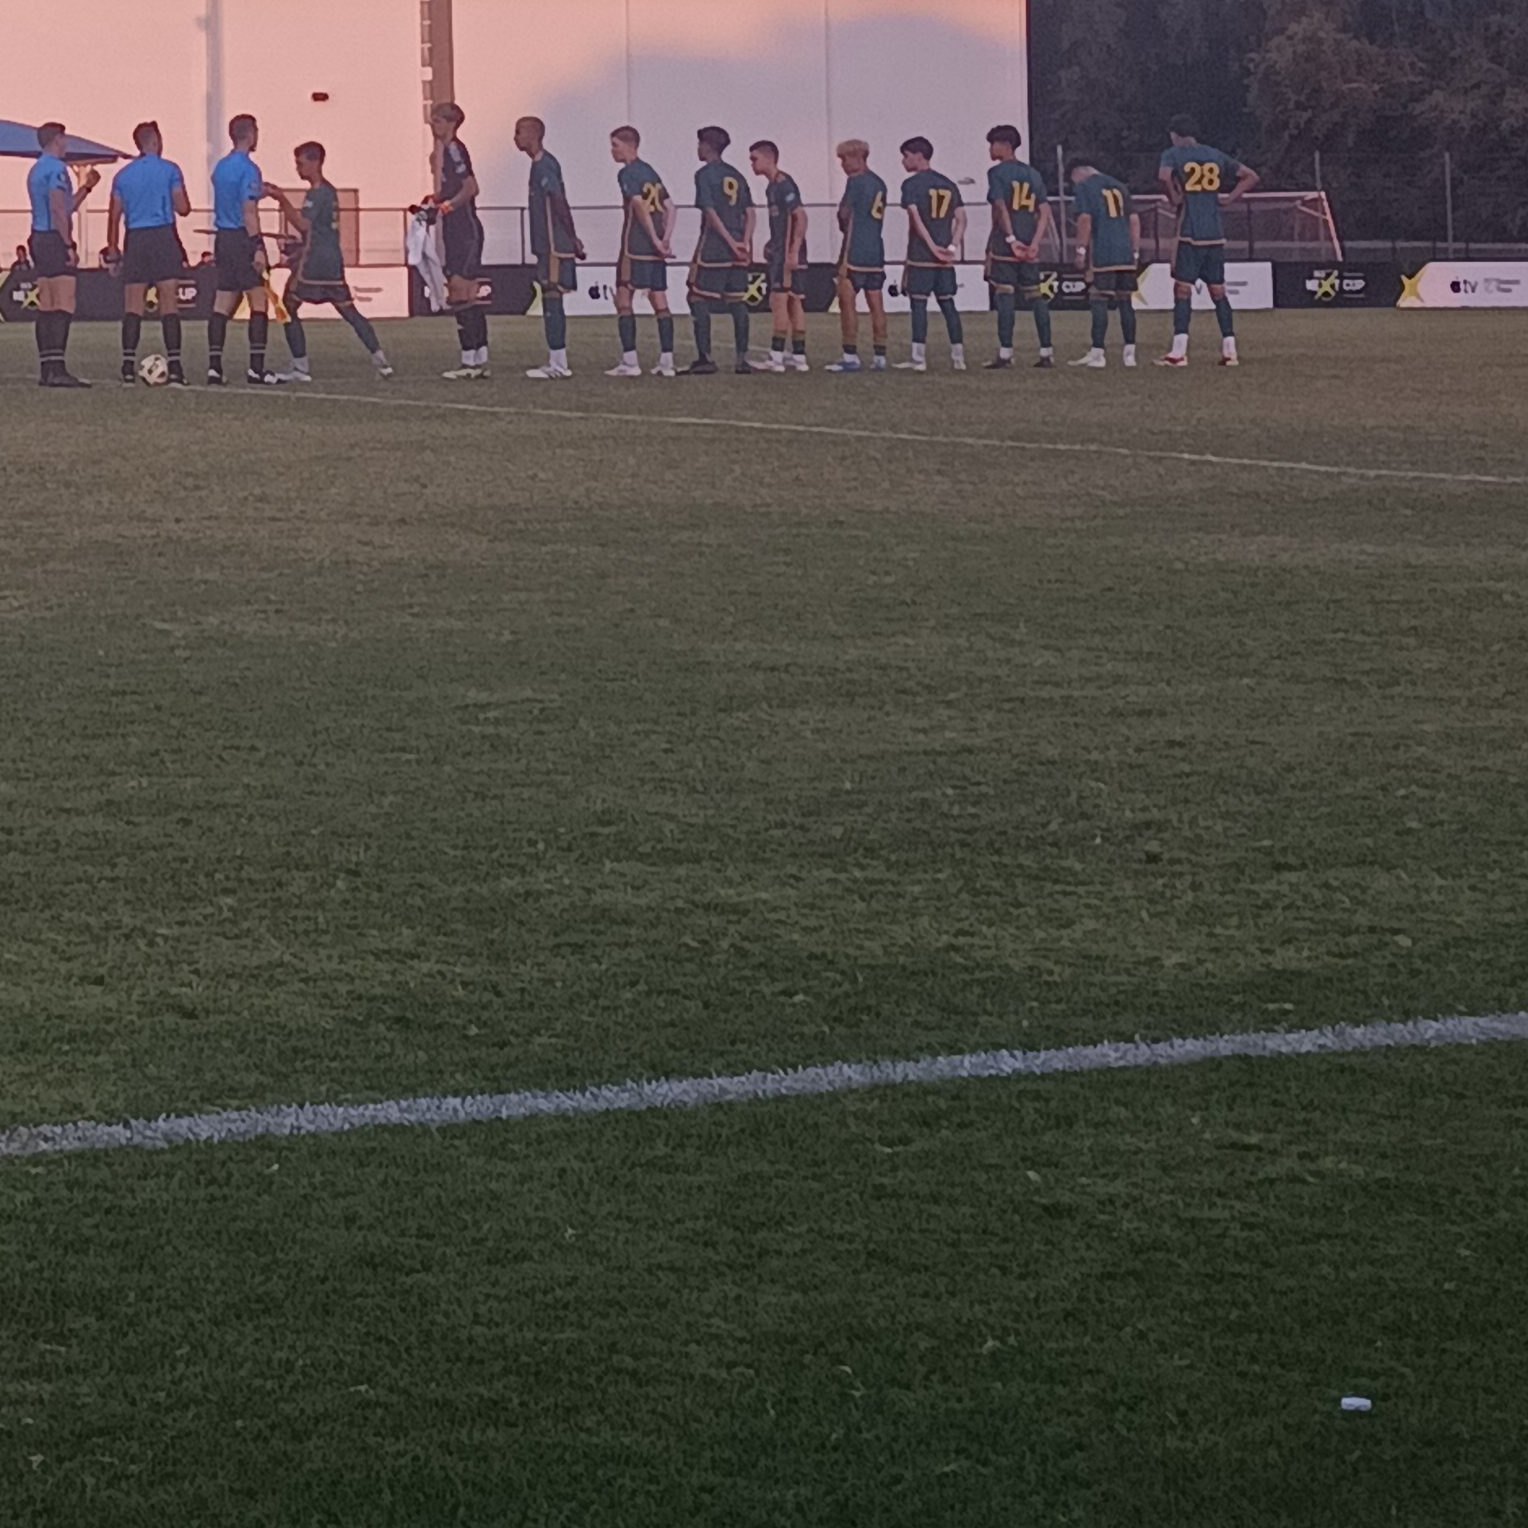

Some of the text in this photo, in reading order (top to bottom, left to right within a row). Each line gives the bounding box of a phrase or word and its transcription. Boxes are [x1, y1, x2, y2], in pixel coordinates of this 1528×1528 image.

[723, 176, 739, 207] 9
[1183, 161, 1221, 192] 28
[871, 190, 884, 220] 6
[929, 188, 952, 219] 17
[1011, 180, 1036, 212] 14
[1102, 187, 1125, 218] 11
